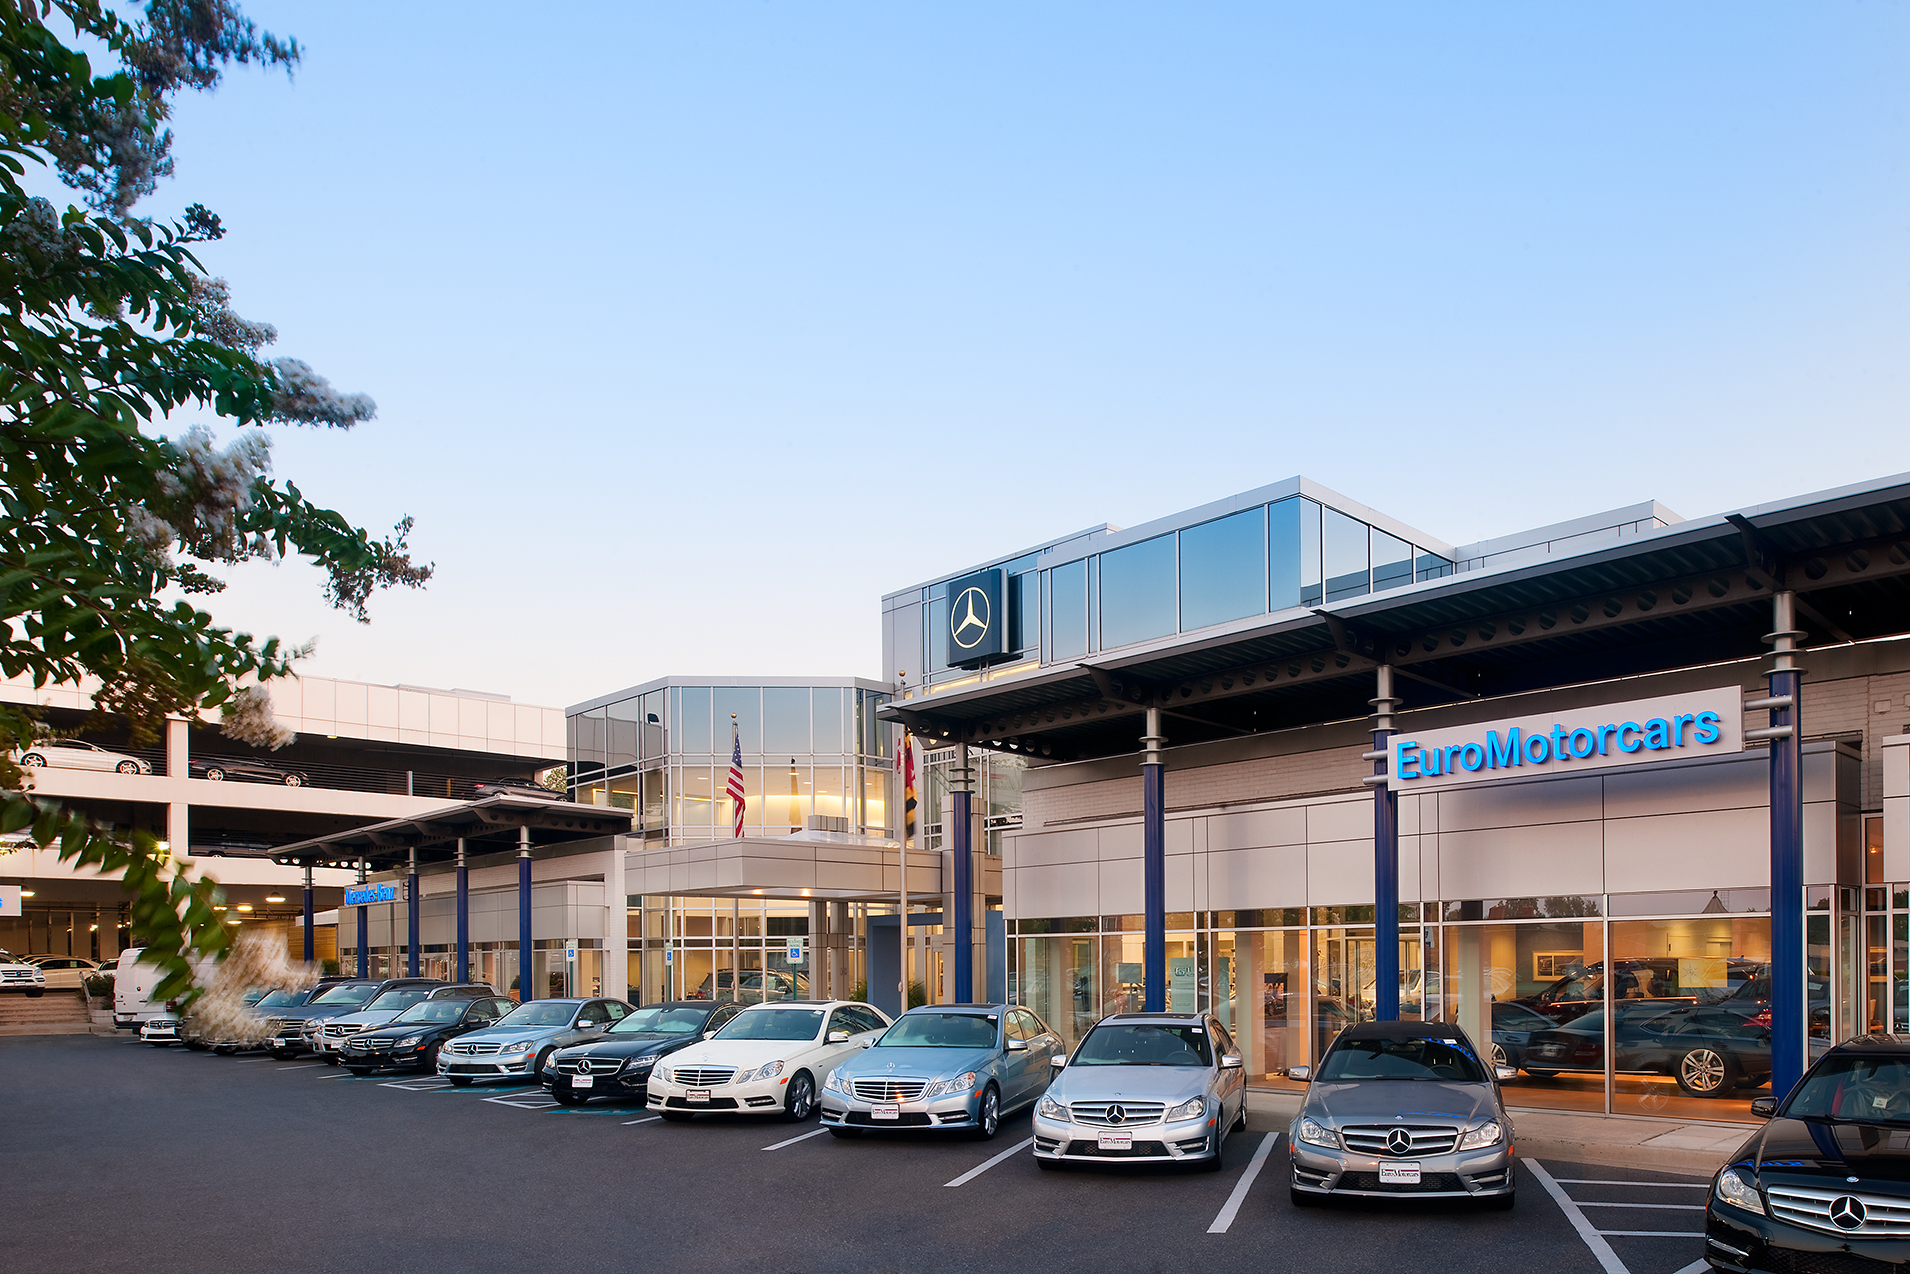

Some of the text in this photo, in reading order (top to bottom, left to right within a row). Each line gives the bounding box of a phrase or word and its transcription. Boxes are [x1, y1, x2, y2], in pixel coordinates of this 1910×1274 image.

[1396, 709, 1721, 780] EuroMotorcars
[345, 883, 396, 905] Mercedes-Benz
[1380, 1168, 1420, 1177] EuroMotorcars
